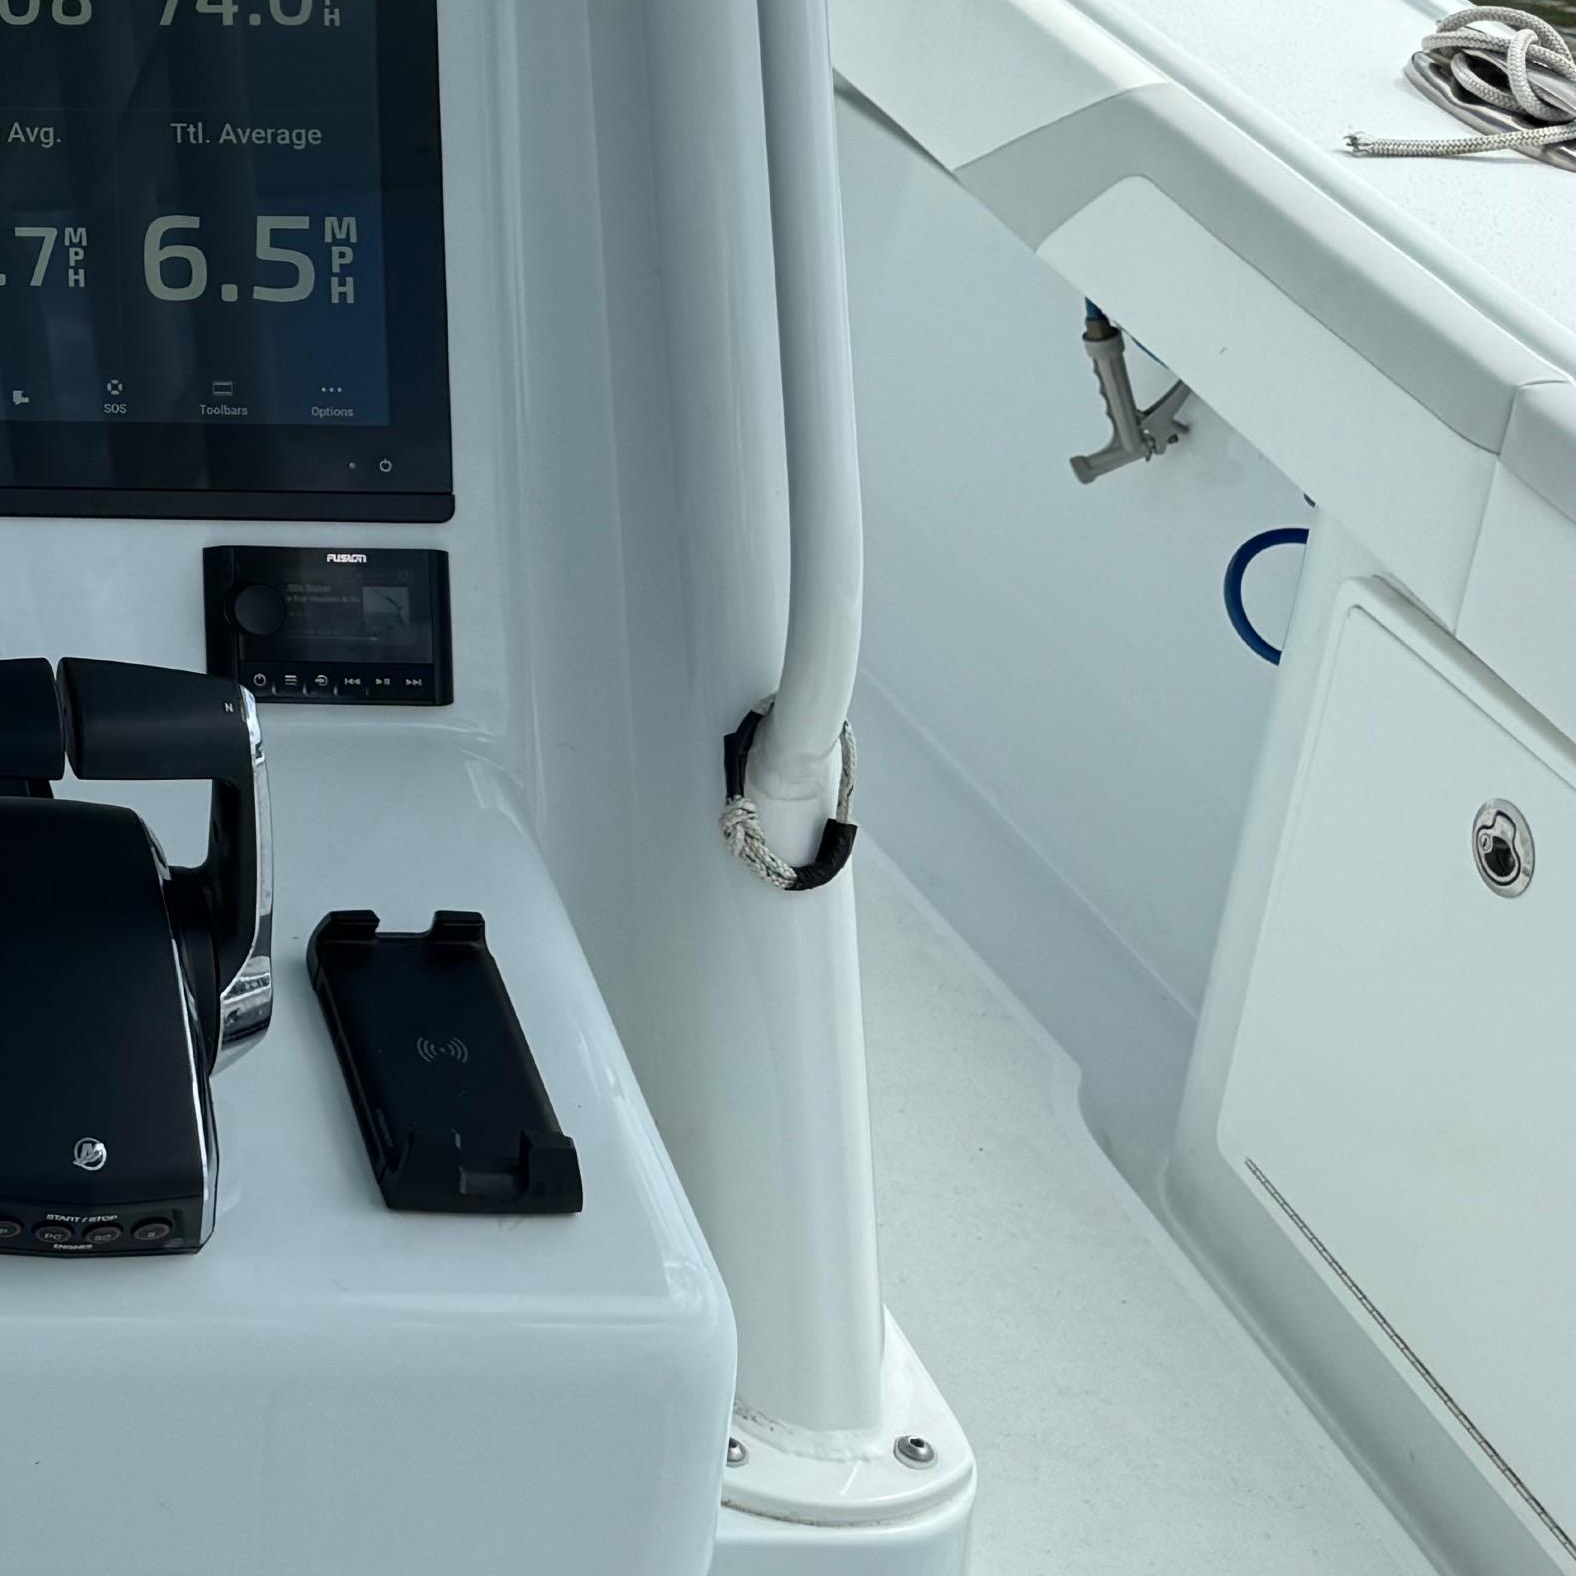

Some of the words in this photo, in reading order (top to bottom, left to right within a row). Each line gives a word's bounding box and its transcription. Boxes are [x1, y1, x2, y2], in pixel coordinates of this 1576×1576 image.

[7, 122, 61, 147] Avg.
[171, 123, 210, 143] Ttl.
[220, 124, 322, 149] Average
[144, 215, 316, 302] 6.5
[103, 403, 127, 414] SOS
[199, 404, 249, 416] Toolbars
[311, 405, 354, 420] Options
[326, 553, 367, 563] FUSION
[224, 701, 234, 712] N
[46, 1213, 81, 1223] START
